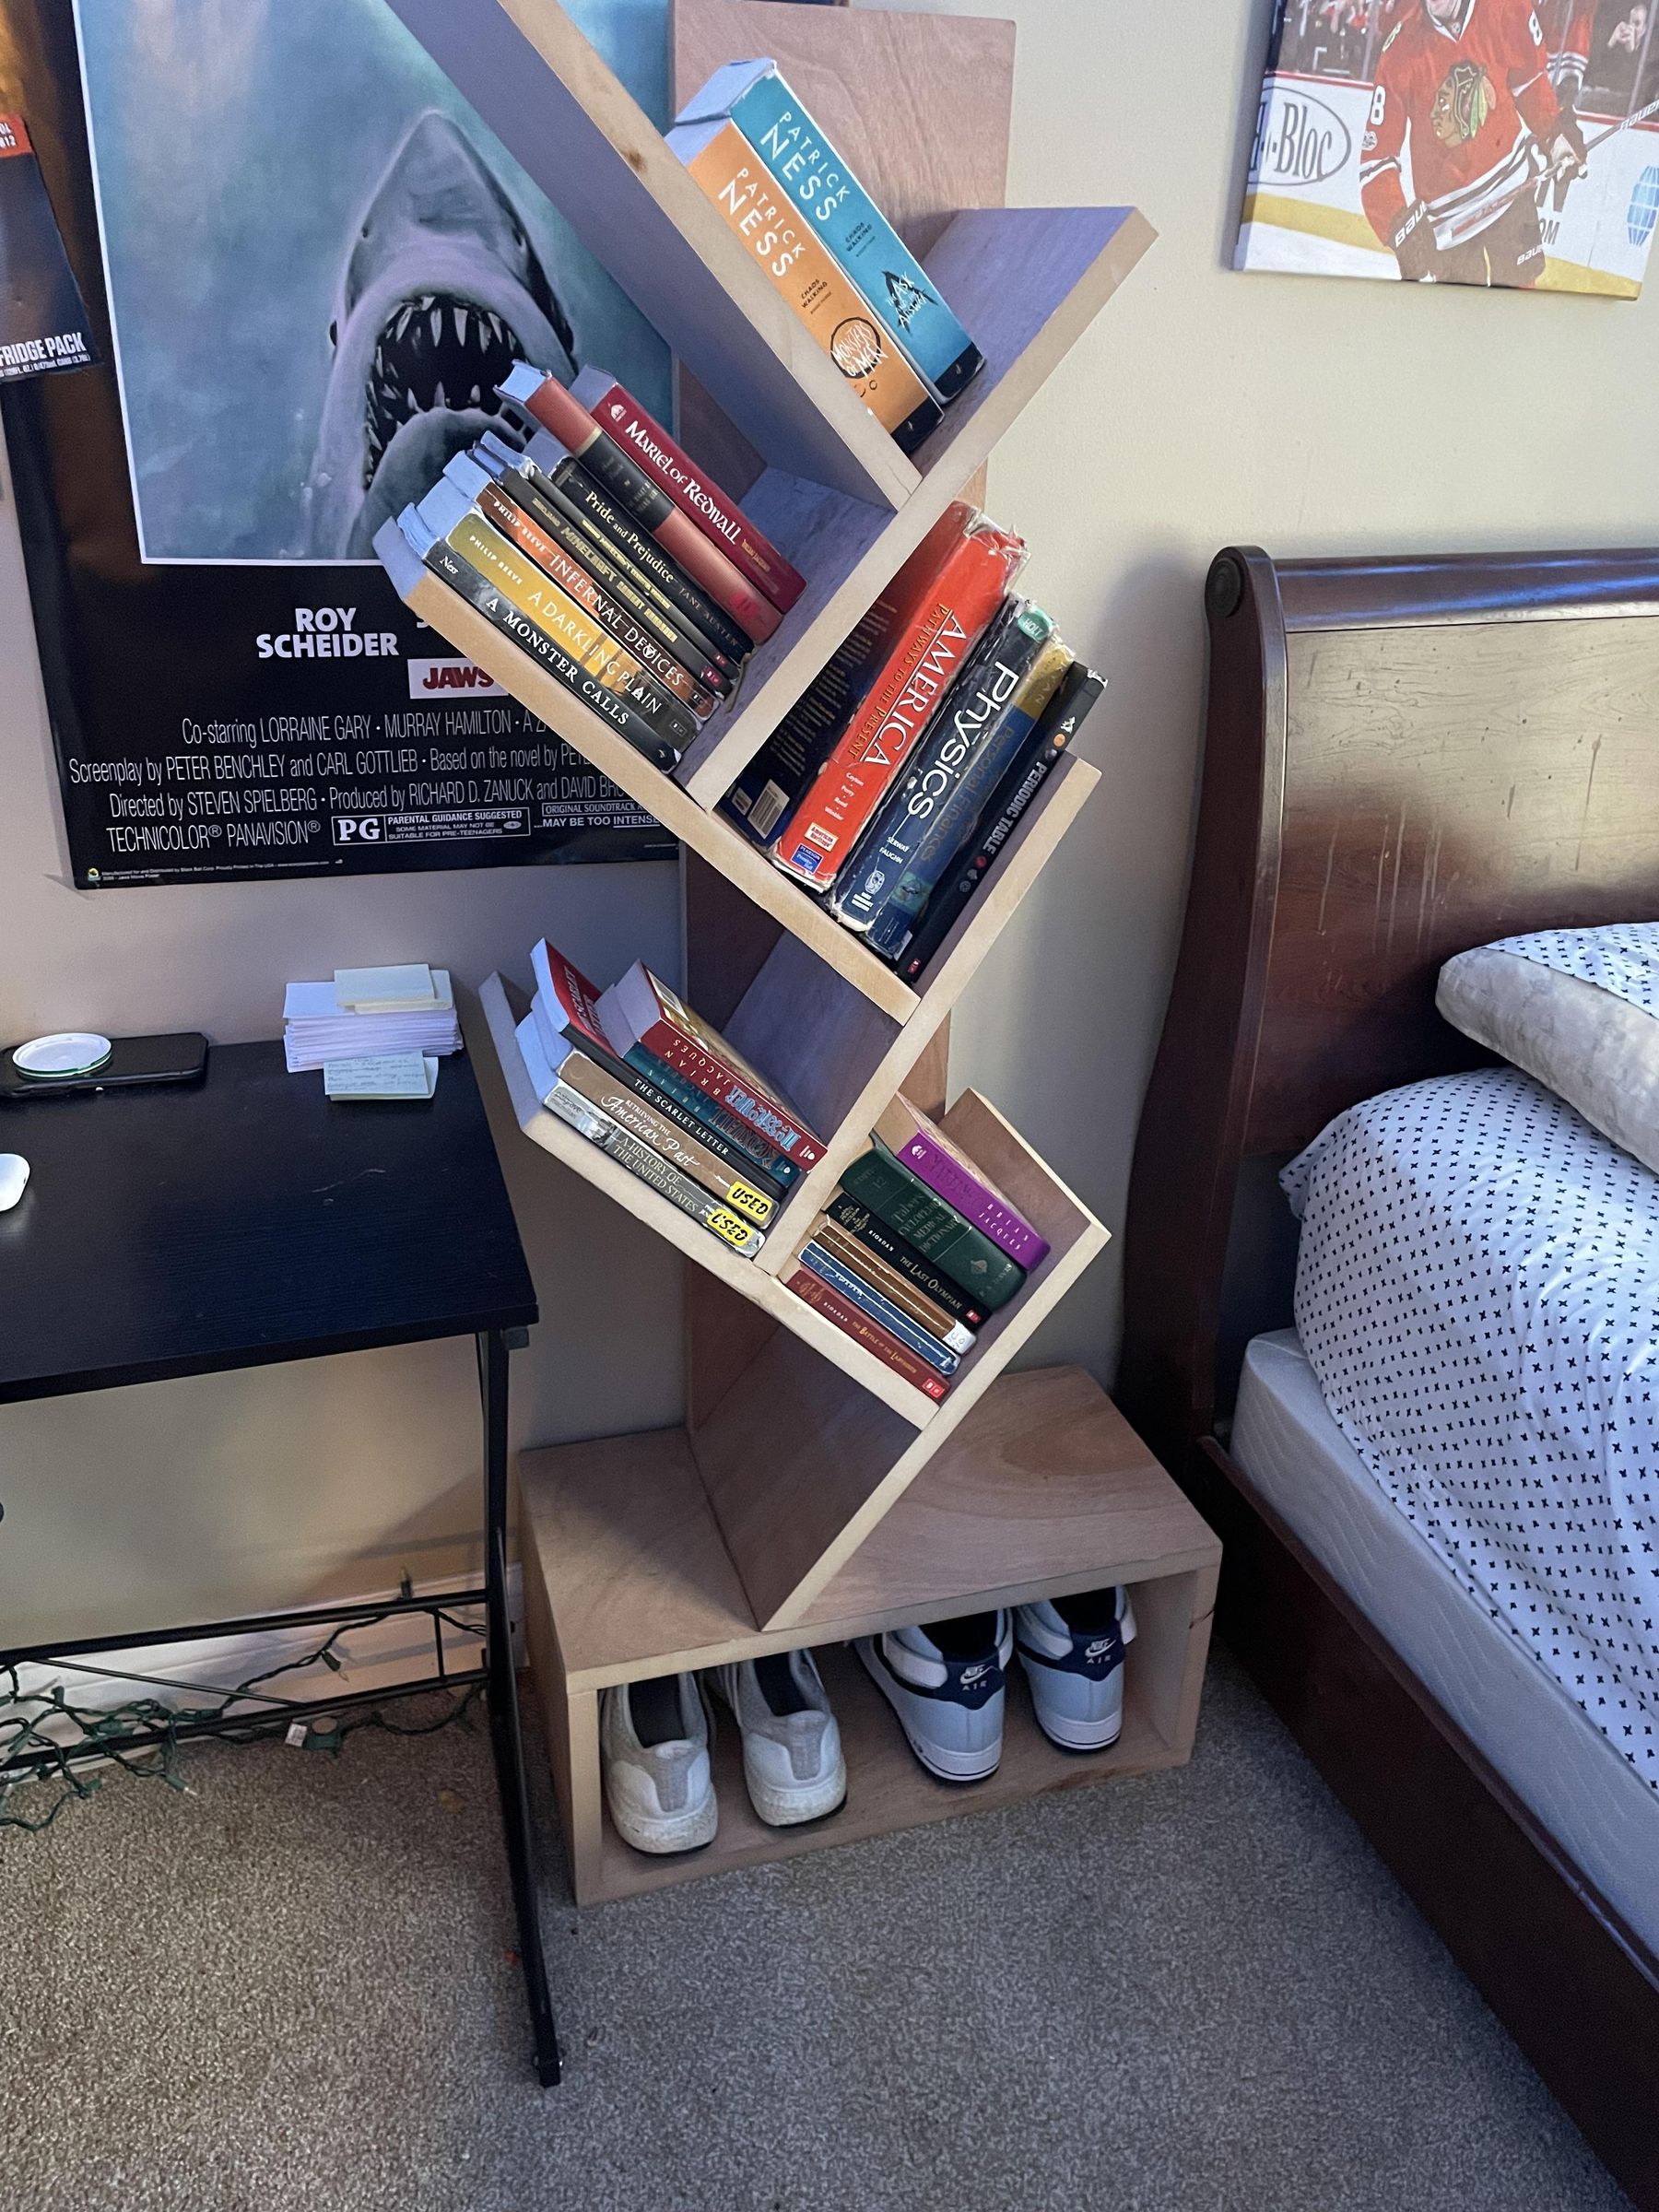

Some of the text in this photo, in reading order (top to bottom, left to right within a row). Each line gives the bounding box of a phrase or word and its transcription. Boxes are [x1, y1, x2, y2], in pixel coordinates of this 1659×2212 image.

[760, 124, 837, 220] NESS
[779, 112, 850, 203] PATRICK
[718, 179, 794, 276] NESS
[736, 167, 806, 258] PATRICK
[846, 224, 872, 252] WALKING
[801, 279, 820, 300] CHAOS
[802, 281, 828, 309] WALKING
[44, 332, 87, 357] PACK
[830, 322, 874, 365] MONSTERS
[492, 500, 520, 528] PHILIP
[560, 527, 617, 583] MINECRAFT
[584, 489, 615, 524] Pride
[612, 521, 629, 538] and
[628, 532, 675, 583] Prejudice
[439, 555, 459, 575] Ness
[468, 535, 523, 585] PHILIP REEVE
[678, 587, 702, 610] JANE
[295, 607, 357, 631] ROY
[548, 554, 623, 629] INFERNAL
[624, 626, 684, 686] DEVICES
[1023, 618, 1044, 636] HOLT
[256, 632, 399, 658] SCHEIDER
[486, 597, 629, 725] A MONSTER CALLS
[528, 591, 662, 714] A DARKLING PLAIN
[422, 666, 495, 689] JAWS
[848, 603, 950, 759] PATHWAYS TO THE PRESENT
[864, 615, 967, 766] AMERICA
[182, 718, 257, 748] Co-starring
[260, 716, 331, 743] LORRAINE
[334, 715, 371, 740] GARY
[384, 712, 441, 738] MURRAY
[445, 710, 512, 735] HAMILTON
[908, 661, 1019, 819] Physics
[69, 758, 142, 786] Screenplay
[146, 757, 162, 785] by
[166, 755, 211, 781] PETER
[214, 754, 285, 779] BENCHLEY
[290, 753, 313, 777] and
[317, 752, 353, 775] CARL
[356, 749, 418, 774] GOTTLIEB
[430, 747, 467, 771] Based
[471, 751, 485, 769] on
[488, 746, 507, 768] the
[511, 744, 540, 767] novel
[545, 744, 559, 771] by
[968, 725, 1013, 791] Personal
[109, 776, 596, 820] Directed by STEVEN SPIELBERG Produced by RICHARD D. ZANUCK and DAVID
[388, 810, 523, 825] PARENTAL GUIDANCE SUGGESTED
[546, 804, 582, 814] ORIGINAL
[584, 802, 636, 812] SOUNDTRACK
[982, 761, 1047, 854] PERIODIC TABLE
[337, 818, 380, 841] PG
[420, 824, 452, 832] MATERIAL
[441, 830, 502, 838] PRE-TEENAGERS
[570, 818, 584, 827] BE
[587, 816, 610, 826] TOO
[879, 847, 904, 865] FAUGHN
[886, 837, 910, 853] SERWAY
[665, 1051, 721, 1096] BRIAN
[673, 1039, 731, 1085] JACQUES
[601, 1096, 661, 1146] American
[662, 1137, 700, 1168] Past
[625, 1100, 672, 1135] RETRIEVING THE
[634, 1079, 730, 1156] THE SCARLET LETTER
[611, 1146, 632, 1163] THE
[632, 1160, 667, 1192] UNITED
[665, 1185, 698, 1212] STATES
[630, 1143, 669, 1176] HISTORY
[666, 1171, 683, 1186] OF
[732, 1187, 769, 1215] USED
[711, 1213, 748, 1241] USED
[914, 1213, 947, 1240] MEDICAL
[918, 1215, 961, 1254] DICTIONARY
[979, 1212, 1021, 1251] JACQUES
[987, 1204, 1029, 1241] BRIAN
[867, 1230, 894, 1252] RIORDAN
[900, 1256, 912, 1269] THE
[910, 1263, 929, 1282] LAST
[927, 1278, 963, 1310] OLYMPIAN
[823, 1301, 849, 1323] RIORDAN
[859, 1326, 879, 1344] BATTLE
[1090, 1638, 1111, 1651] NIKE
[965, 1664, 986, 1677] NIKE
